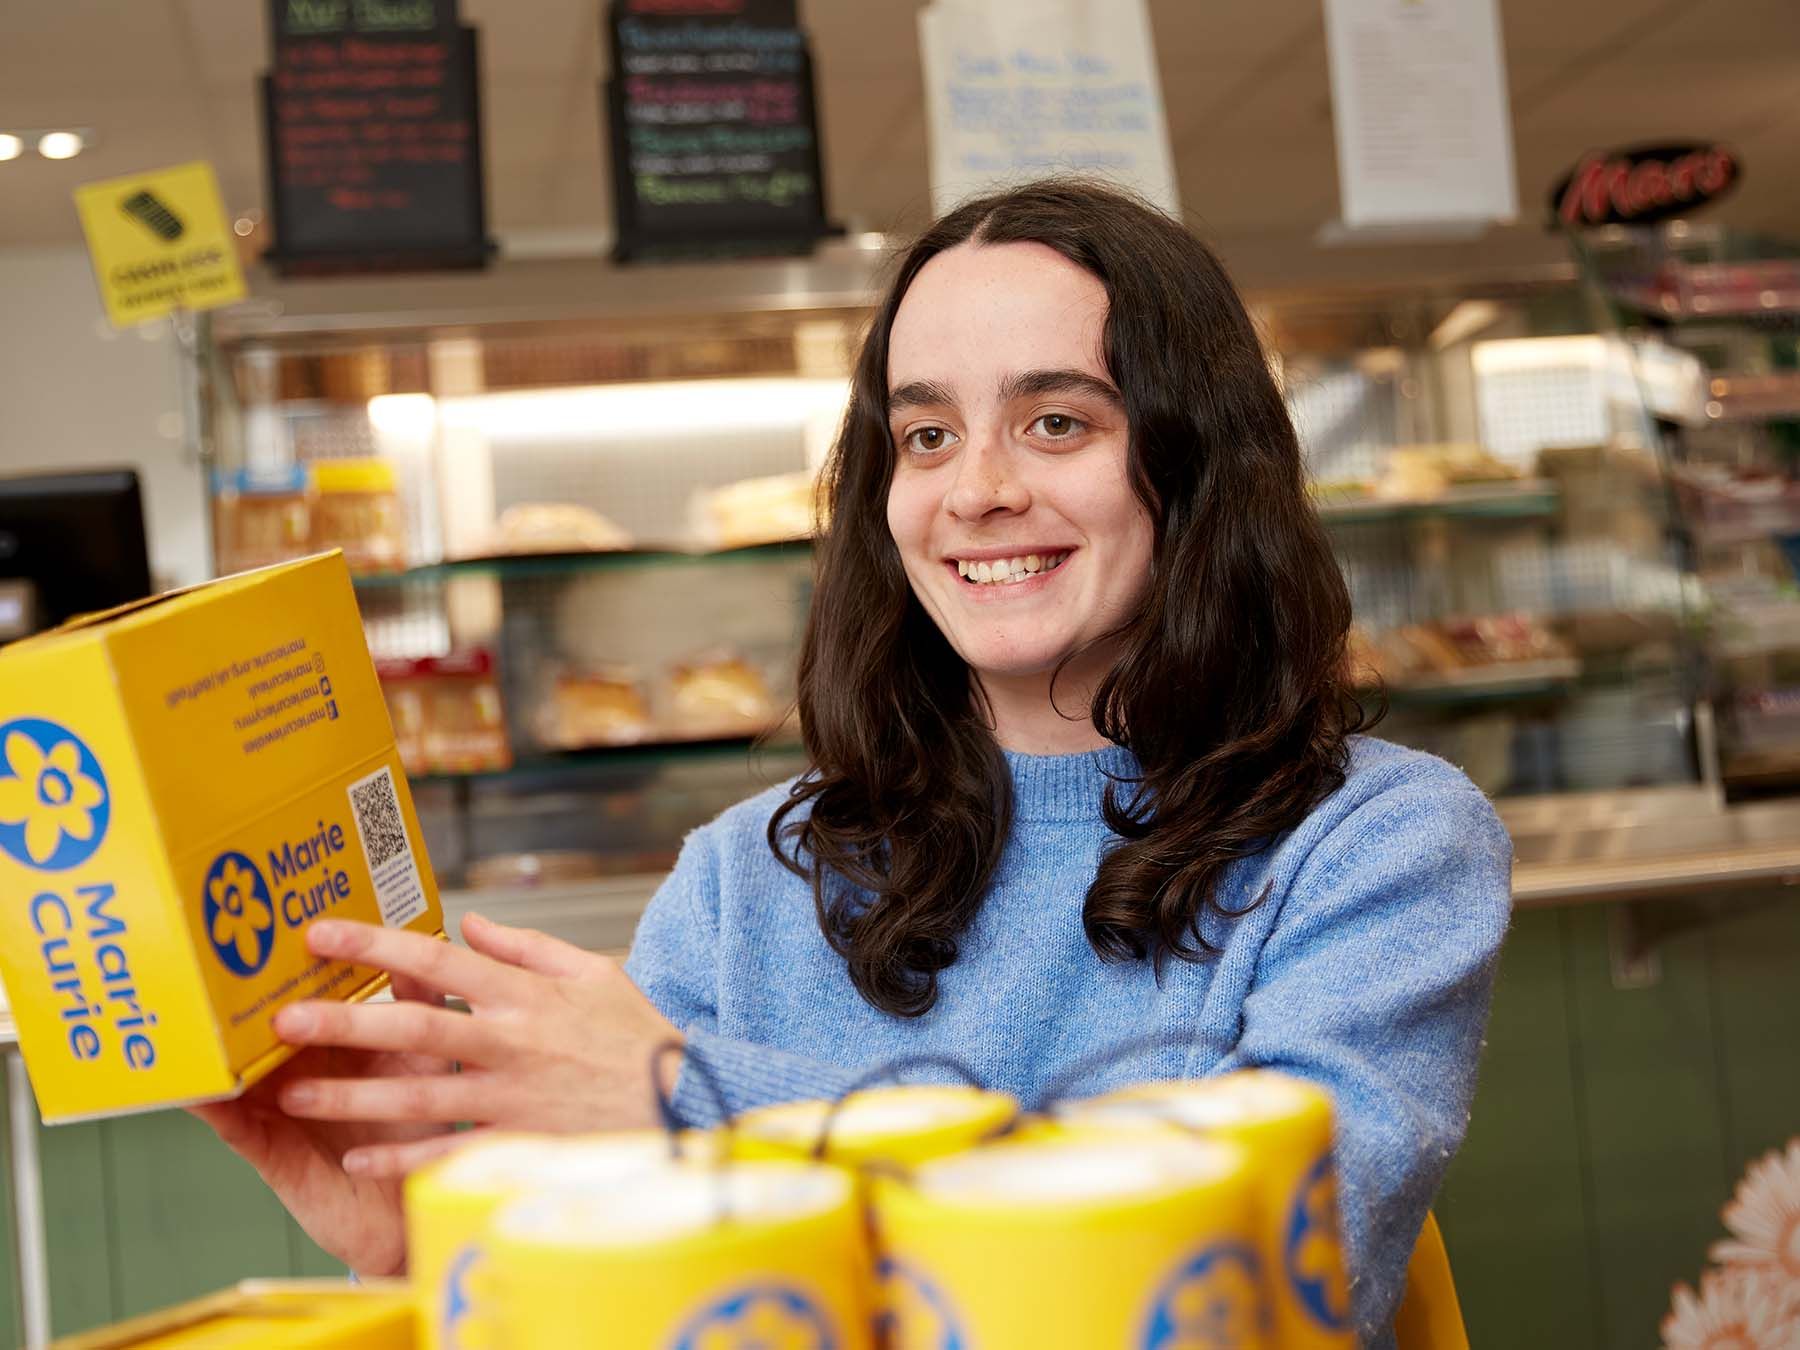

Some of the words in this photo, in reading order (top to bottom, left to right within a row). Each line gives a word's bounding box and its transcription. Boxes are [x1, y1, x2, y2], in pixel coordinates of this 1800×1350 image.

[1560, 147, 1732, 224] Mars
[268, 820, 345, 886] Marie
[282, 867, 350, 928] Curie
[30, 891, 101, 1060] Curie
[76, 883, 157, 1069] Marie
